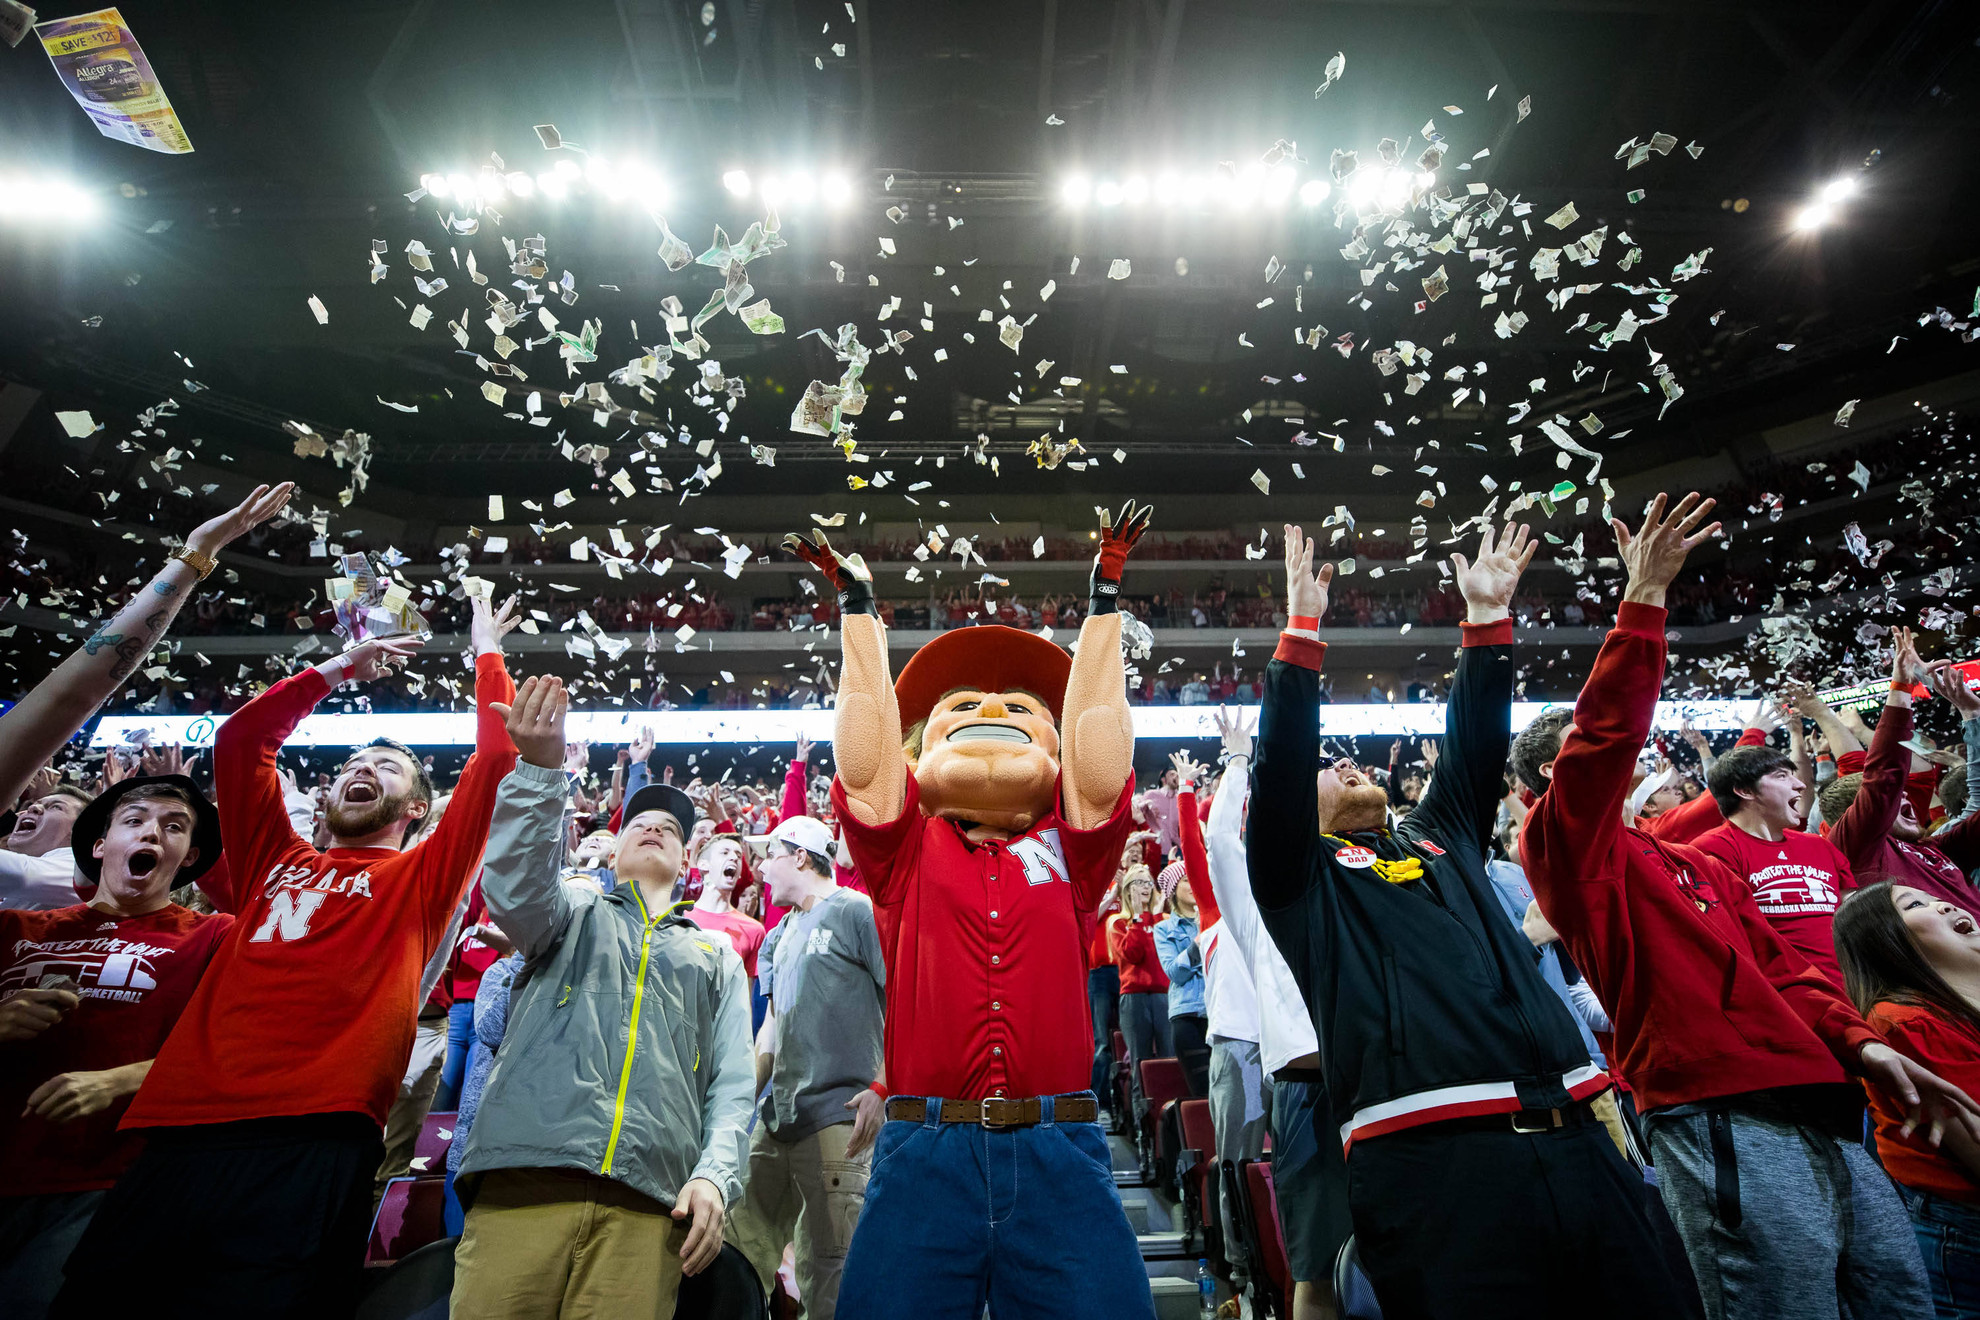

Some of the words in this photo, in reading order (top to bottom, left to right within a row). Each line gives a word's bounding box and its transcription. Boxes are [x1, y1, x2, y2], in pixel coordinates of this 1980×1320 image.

[61, 37, 87, 51] SAVE
[76, 63, 114, 78] Allegra
[1006, 828, 1071, 886] N
[1749, 865, 1785, 887] PROTECT
[1784, 865, 1803, 876] THE
[249, 889, 327, 942] N
[1758, 904, 1800, 914] NEBRASKA
[12, 939, 90, 957] PROTECT
[88, 937, 127, 952] THE
[78, 987, 143, 1003] ASKETBALL
